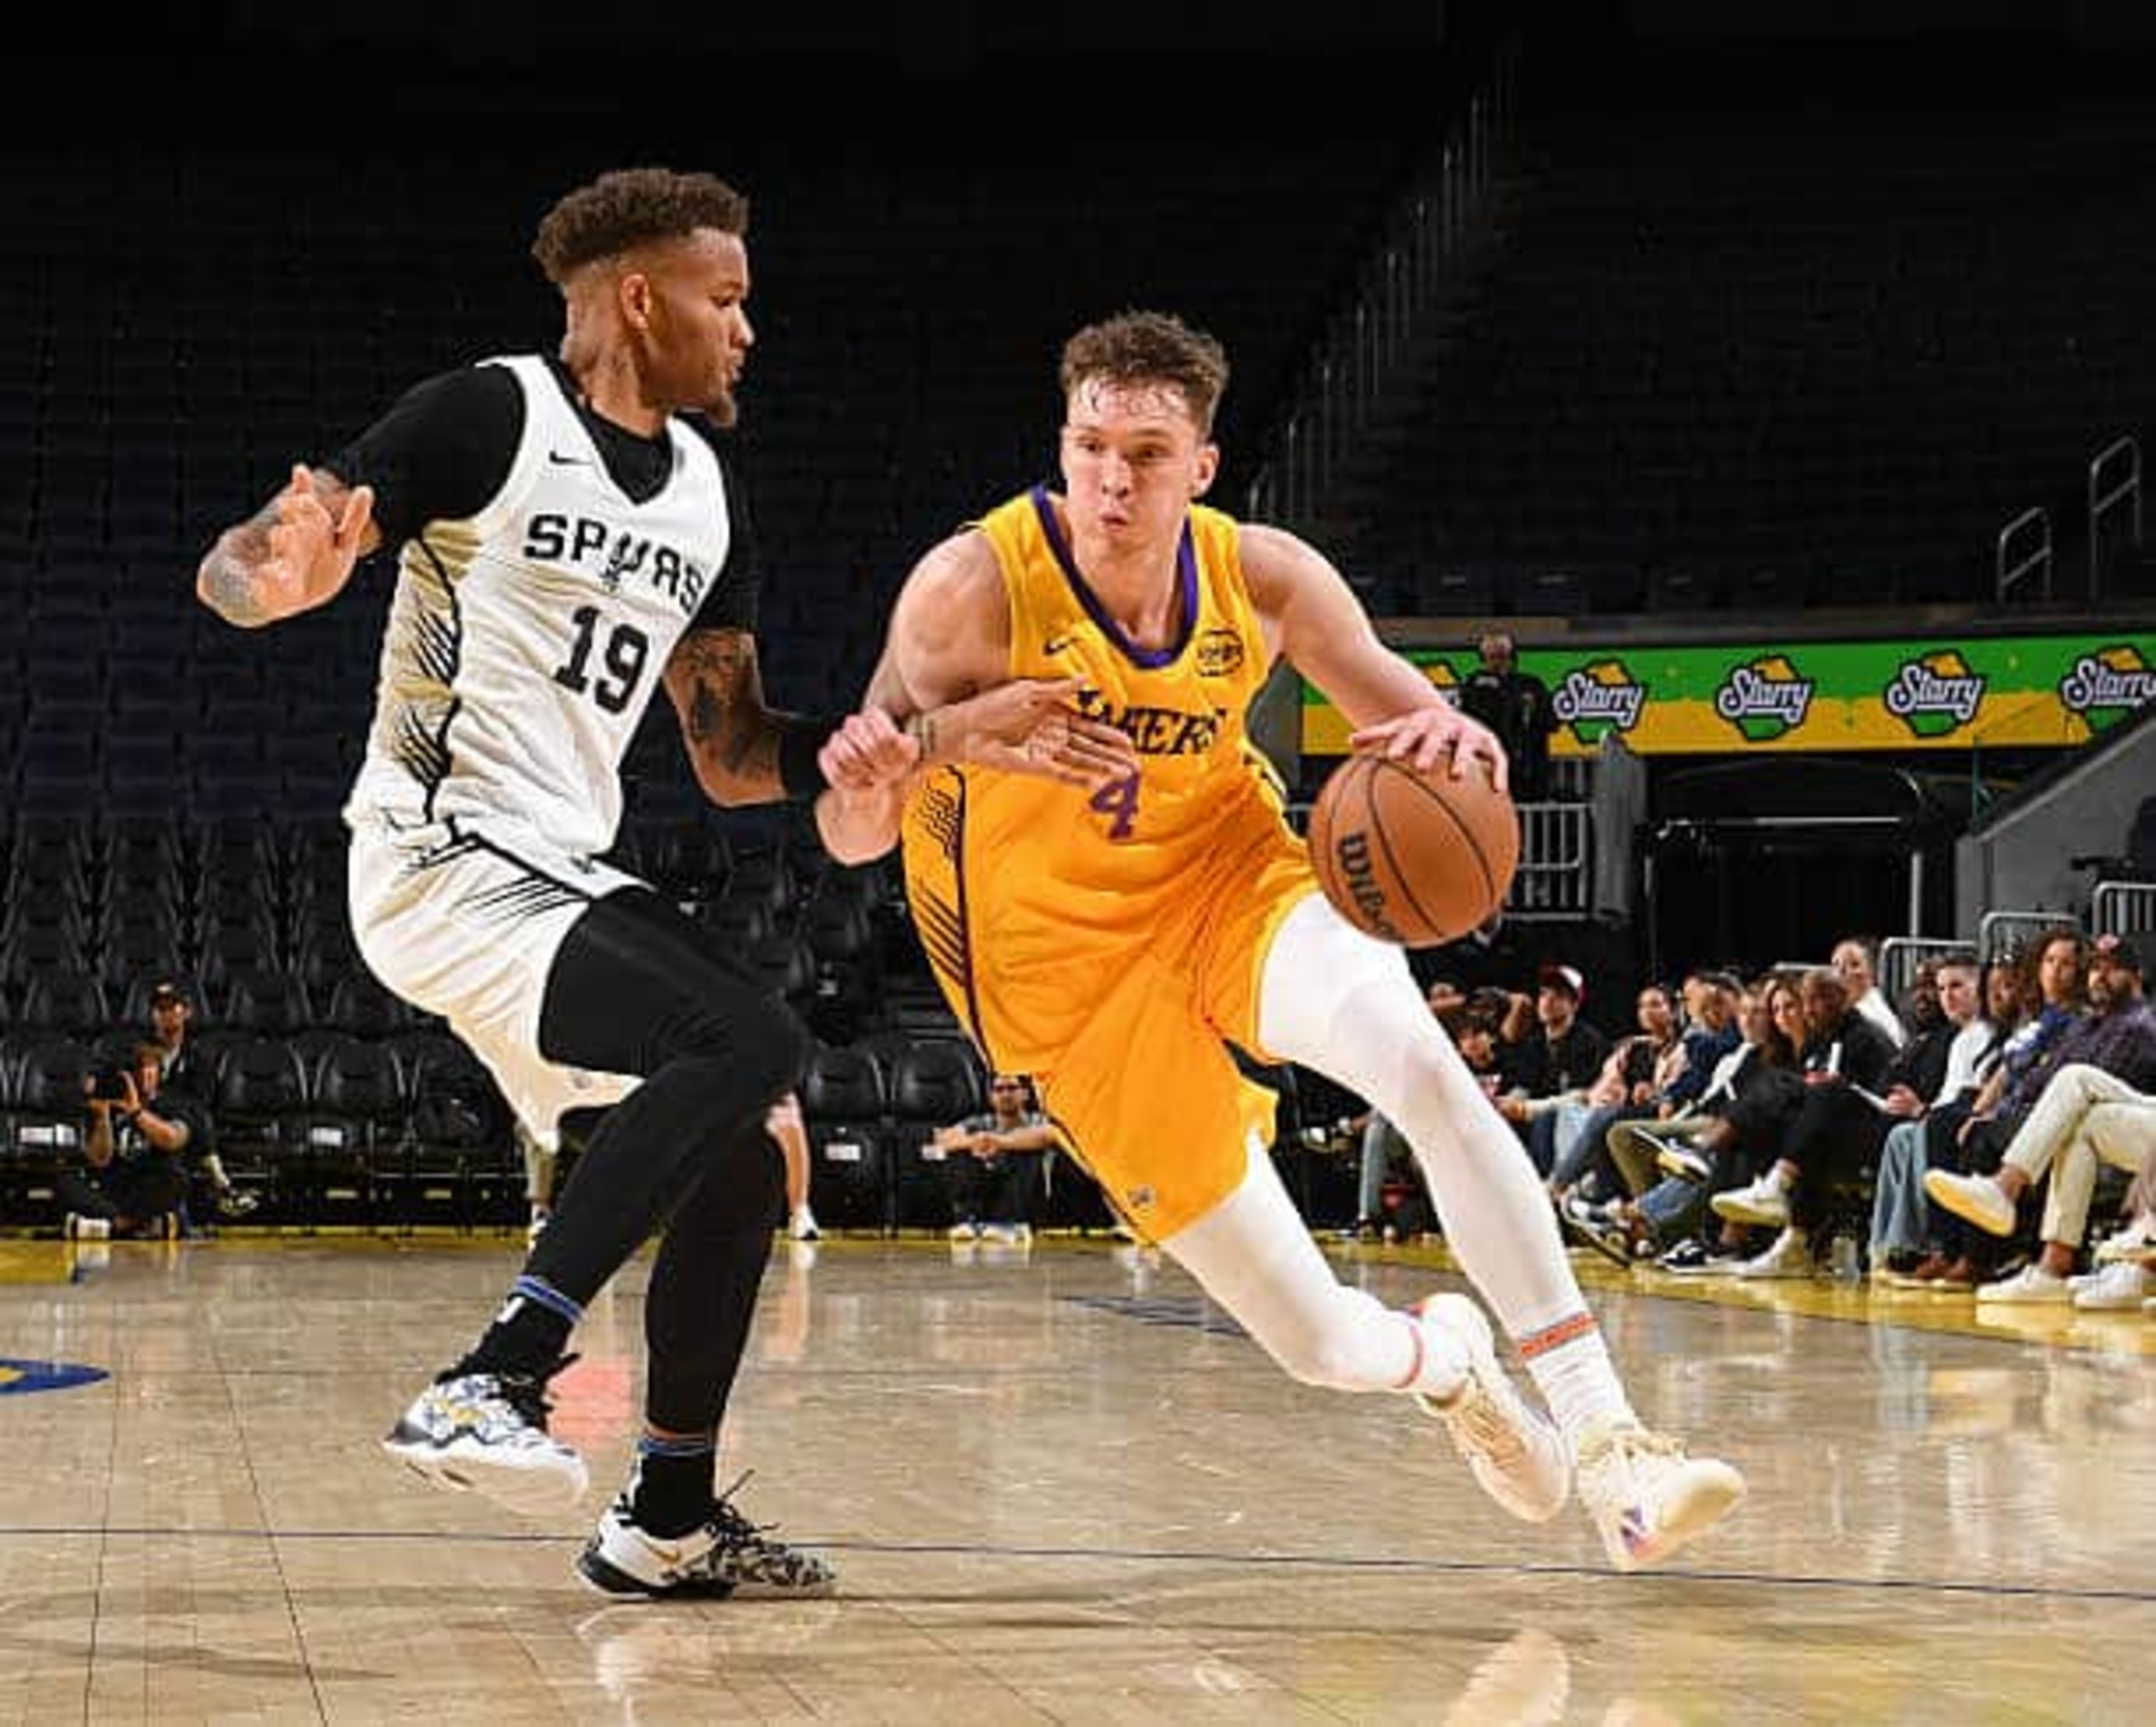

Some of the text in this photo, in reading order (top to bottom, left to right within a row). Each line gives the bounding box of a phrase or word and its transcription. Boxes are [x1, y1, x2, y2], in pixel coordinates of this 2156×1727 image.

[523, 513, 705, 616] SPURS
[552, 605, 649, 714] 19
[1888, 663, 1983, 720] Starry
[1552, 671, 1643, 727] Starry
[1718, 669, 1812, 724] Starry
[1089, 768, 1140, 840] 4
